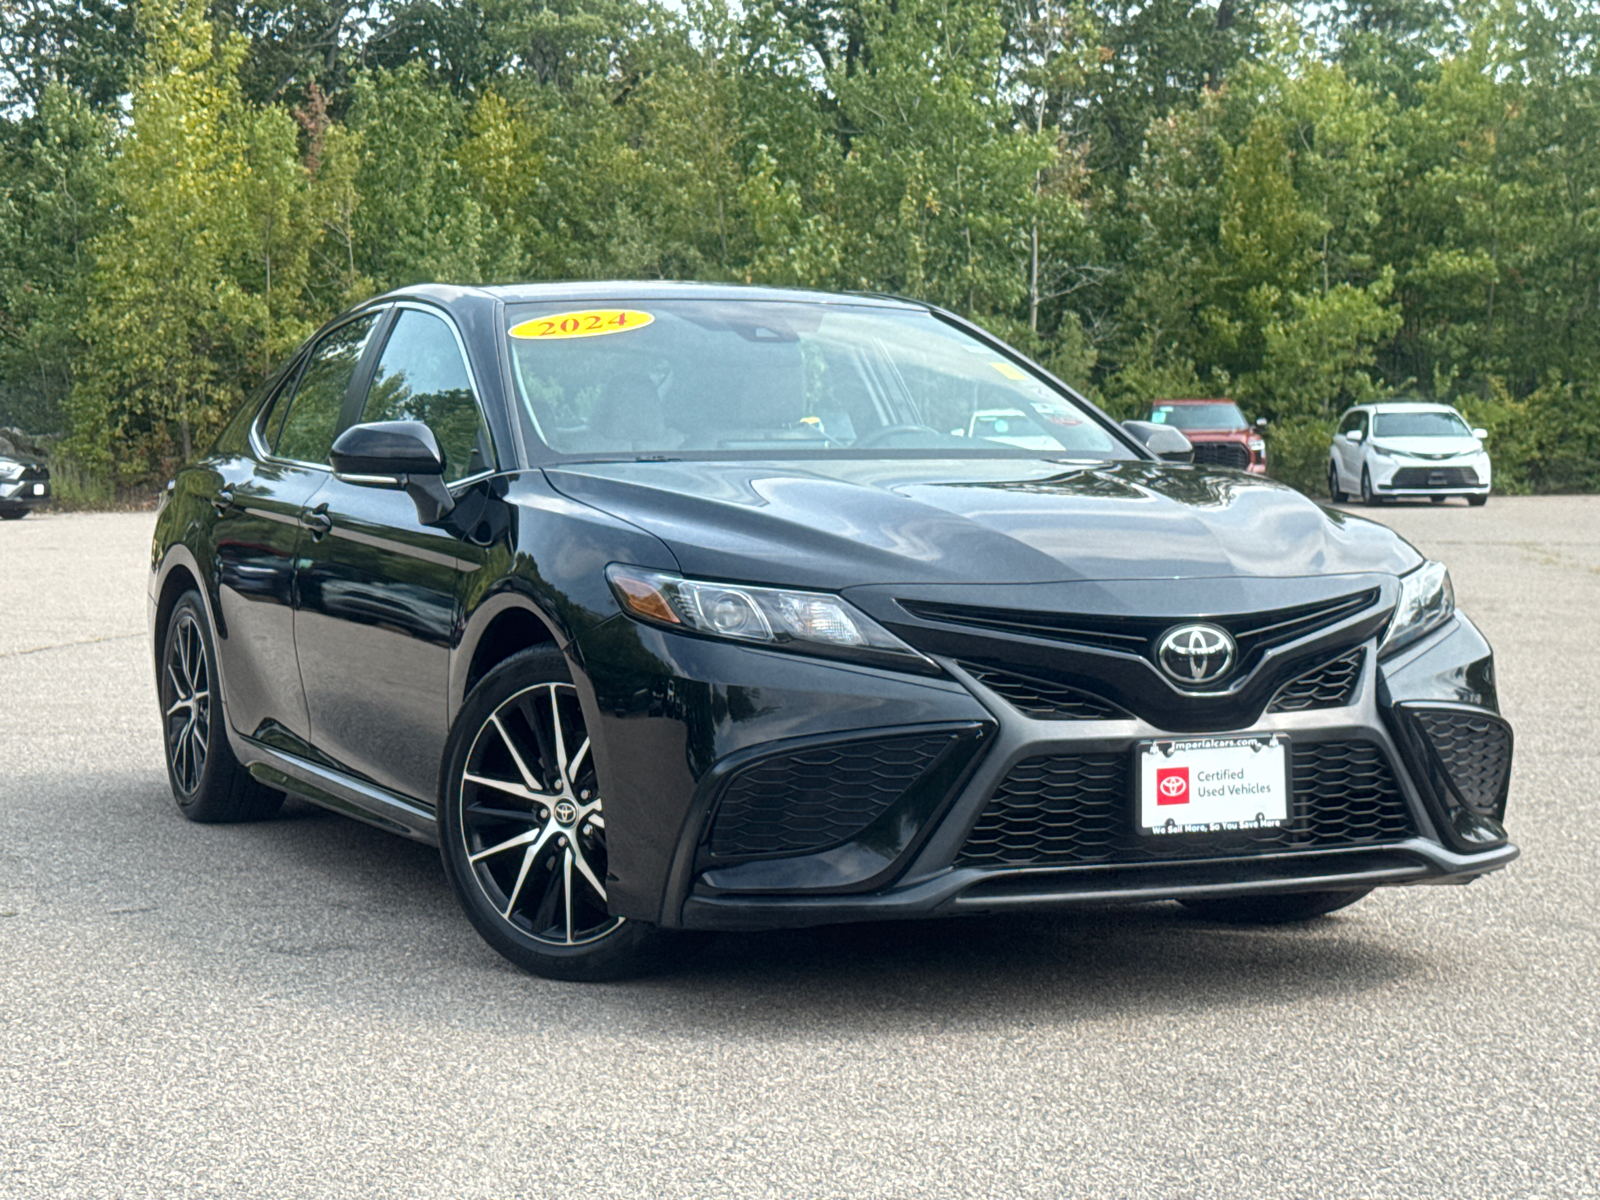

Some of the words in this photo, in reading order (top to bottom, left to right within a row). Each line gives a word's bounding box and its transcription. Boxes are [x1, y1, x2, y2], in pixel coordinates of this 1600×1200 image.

[538, 312, 628, 337] 2024
[1197, 768, 1244, 782] Certified
[1198, 786, 1225, 797] Used
[1227, 783, 1271, 795] Vehicles
[1152, 826, 1166, 835] We
[1167, 825, 1182, 834] Sell
[1210, 822, 1220, 831] So
[1222, 821, 1237, 830] You
[1239, 820, 1258, 829] Save
[1260, 819, 1280, 828] More
